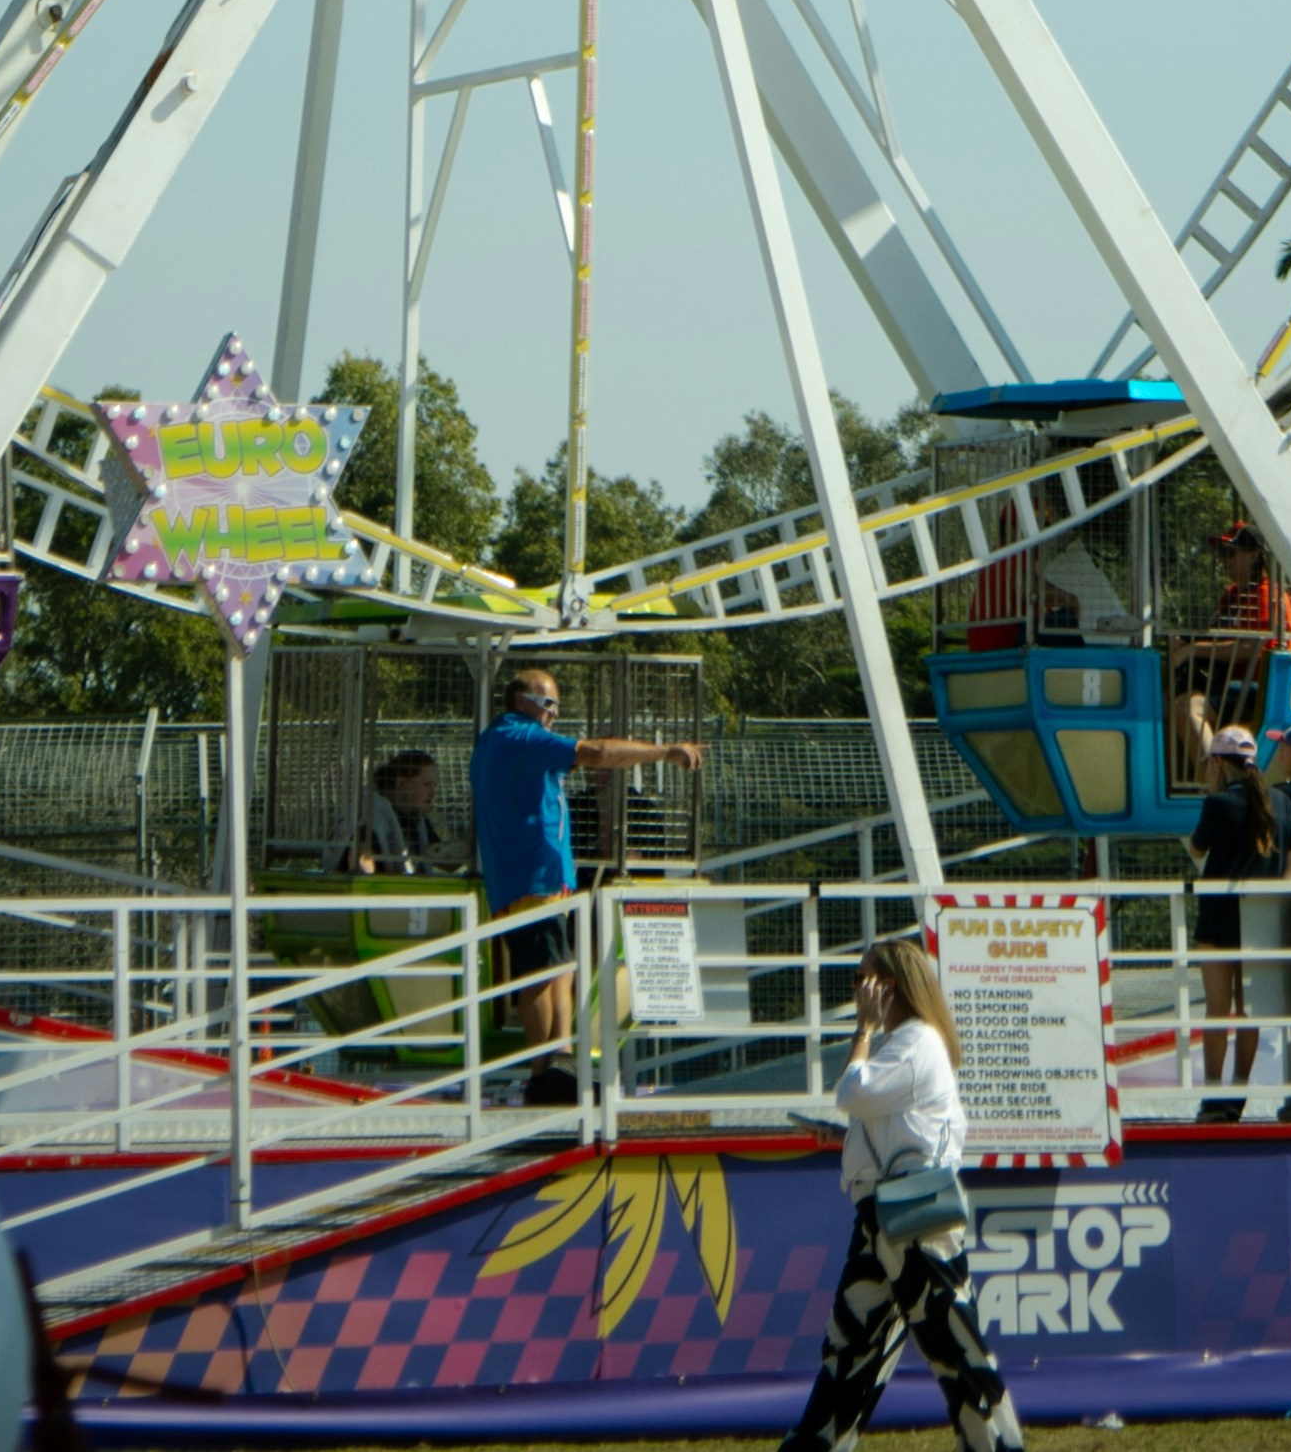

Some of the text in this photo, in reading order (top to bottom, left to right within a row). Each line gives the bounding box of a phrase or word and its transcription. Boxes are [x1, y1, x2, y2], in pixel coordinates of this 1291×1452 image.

[157, 417, 327, 480] EURO
[150, 504, 351, 566] WHEEL
[1082, 668, 1101, 706] 8
[625, 904, 687, 914] ATTENTION
[948, 919, 988, 937] FUN
[1010, 919, 1083, 937] SAFETY
[987, 940, 1048, 958] GUIDE
[949, 965, 1086, 974] PLEASE OBEY THE INSTRUCTIONS
[980, 975, 1056, 983] OF THE OPERATOR
[954, 990, 1033, 999] NO STANDING
[954, 1003, 1029, 1013] NO SMOKING
[956, 1016, 1066, 1026] NO FOOD OR DRINK
[976, 1030, 1031, 1039] ALCOHOL
[977, 1043, 1029, 1053] SPITTING
[978, 1056, 1029, 1066] ROCKING
[958, 1070, 1098, 1079] NO THROWING OBJECTS
[959, 1083, 1047, 1092] FROM THE RIDE
[1007, 1096, 1052, 1106] SECURE
[968, 1110, 1061, 1120] LL LOOSE ITEMS
[967, 1186, 1171, 1272] STOP
[976, 1271, 1124, 1337] ARK
